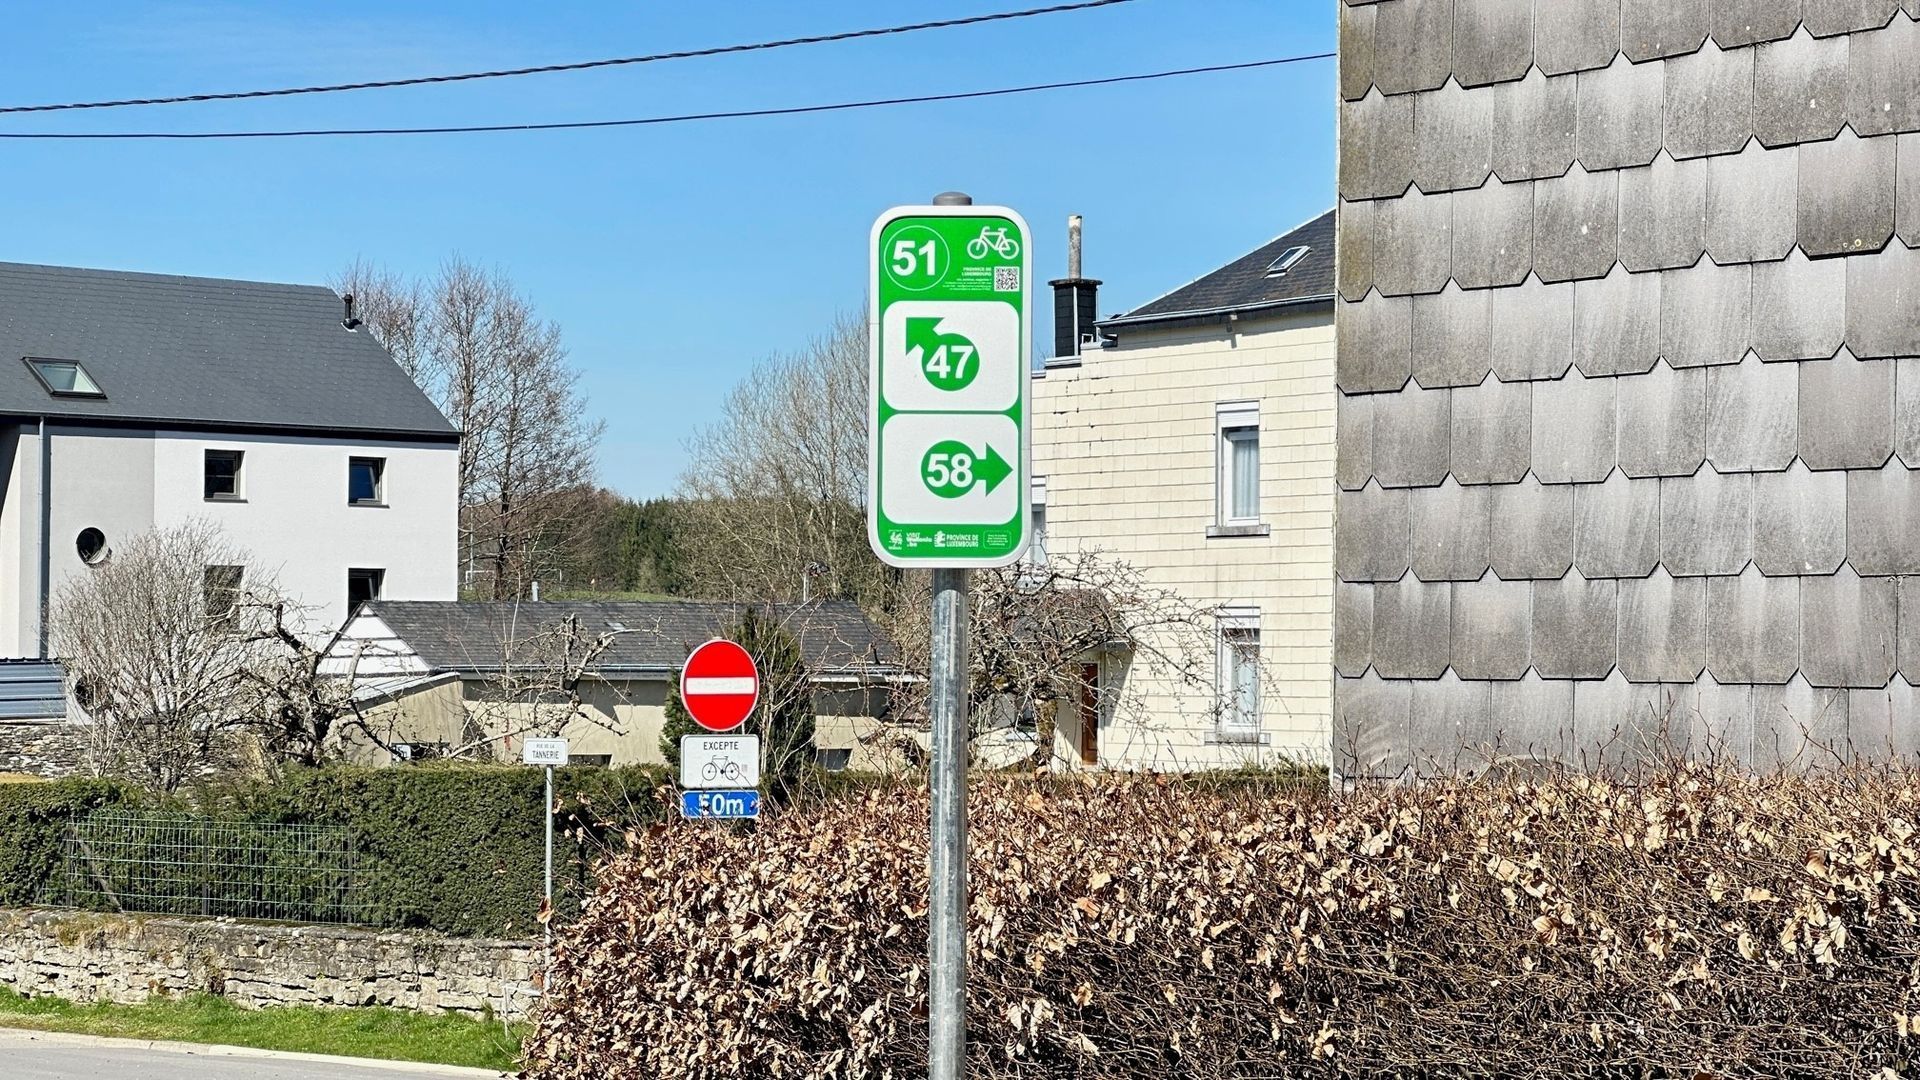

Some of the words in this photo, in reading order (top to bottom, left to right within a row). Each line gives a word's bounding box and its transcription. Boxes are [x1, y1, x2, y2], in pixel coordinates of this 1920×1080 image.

[892, 240, 936, 276] 51
[926, 345, 974, 379] 47
[926, 453, 973, 487] 58
[532, 750, 560, 759] TANNERIE
[703, 741, 739, 751] EXCEPTE
[699, 793, 744, 816] 50m
